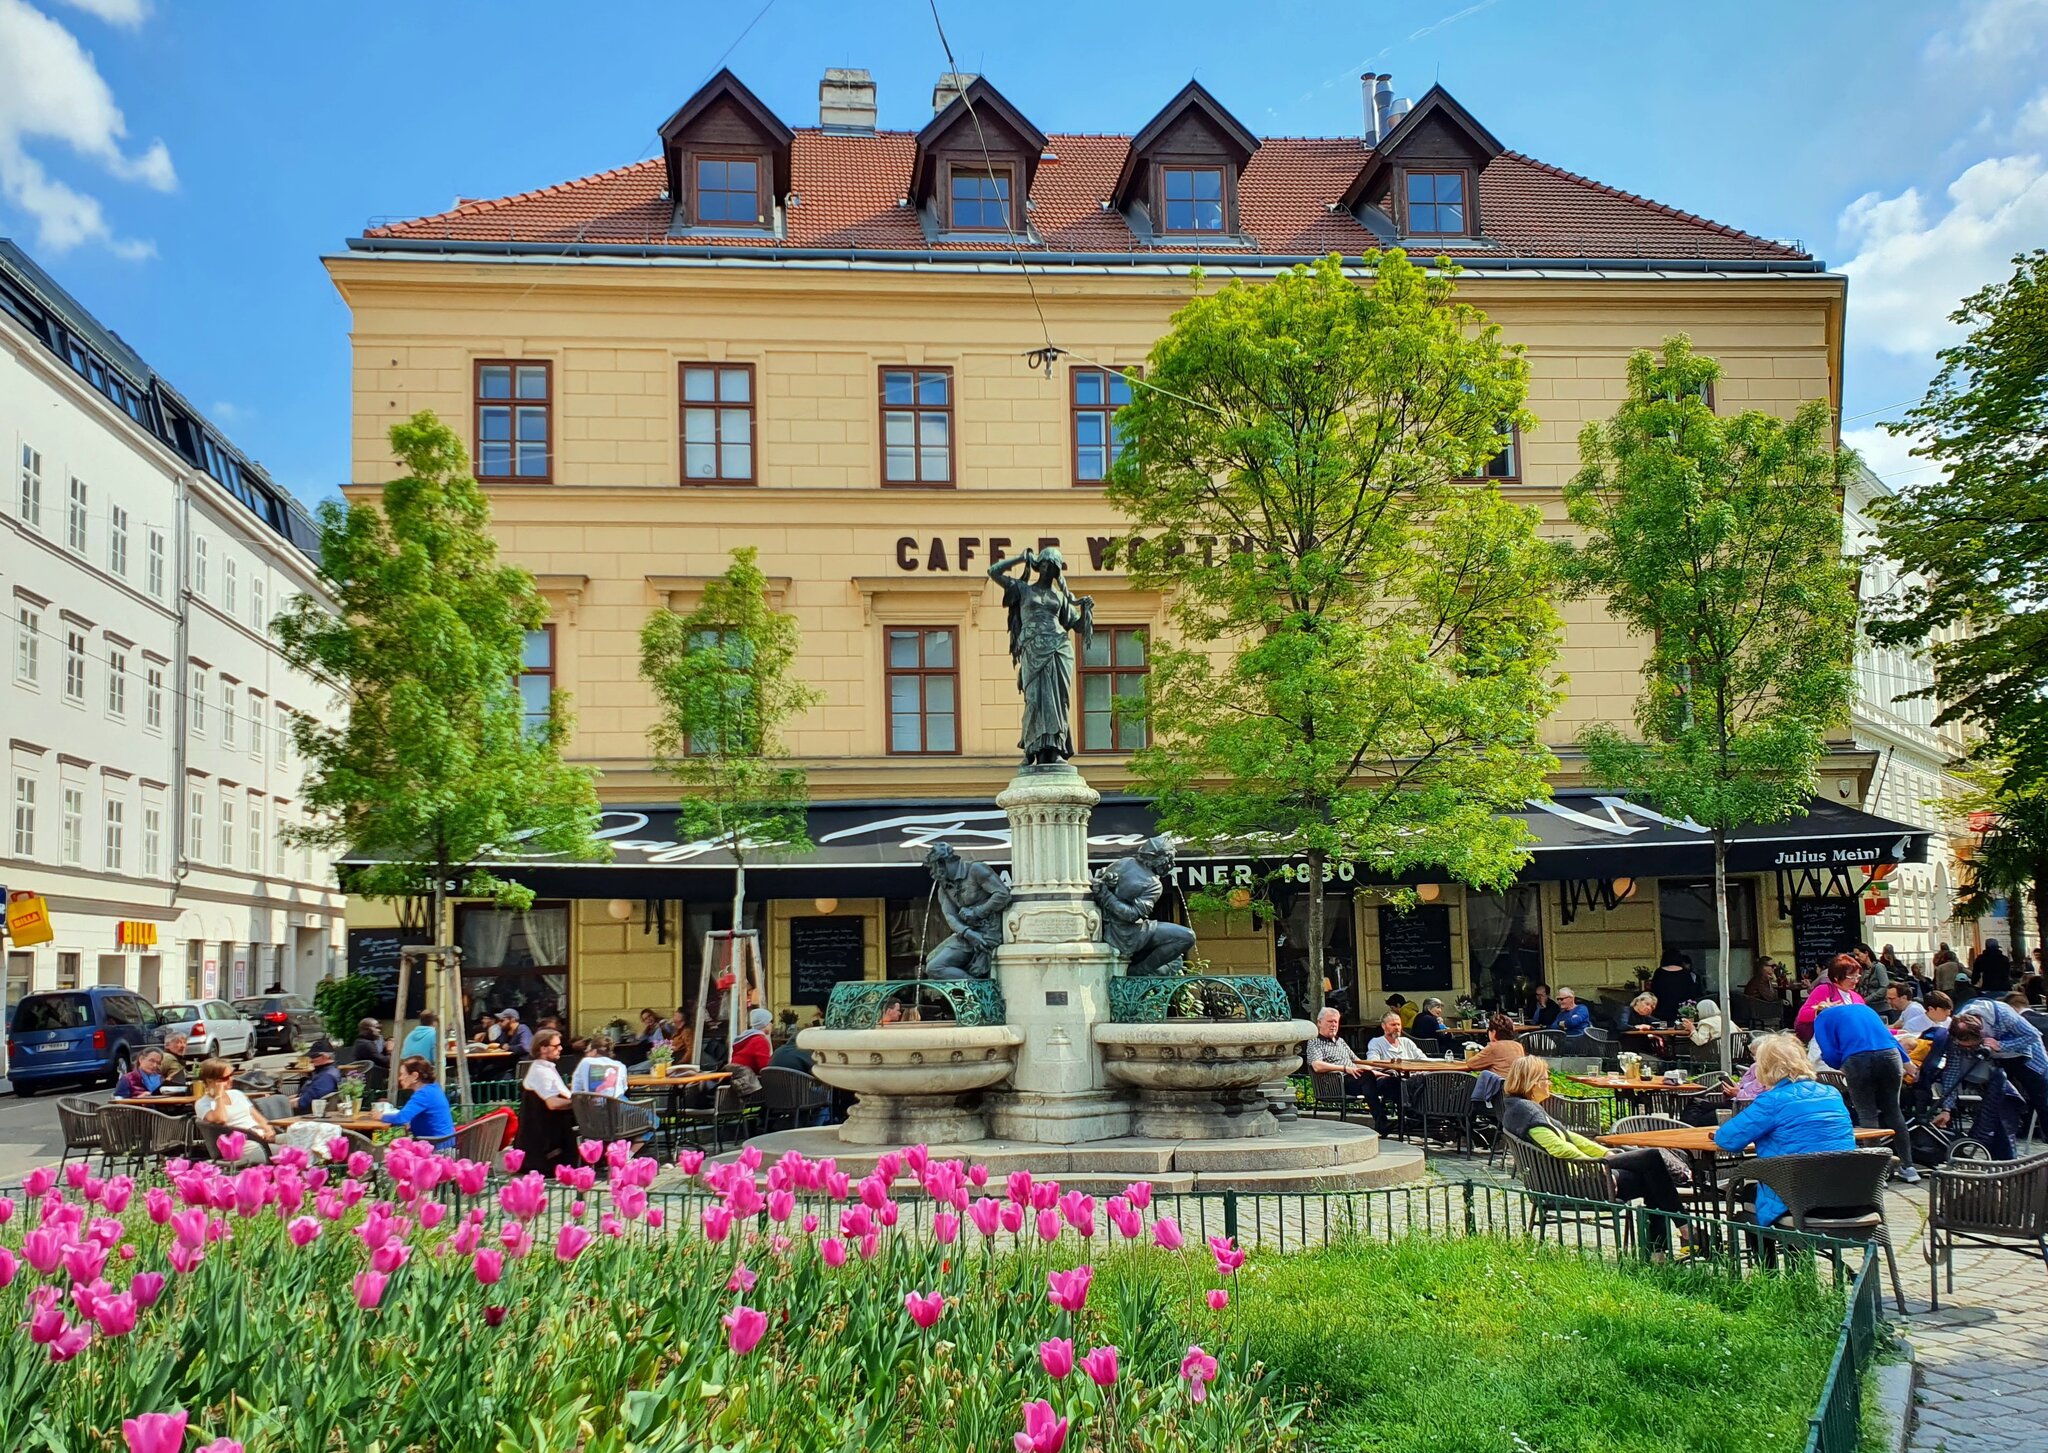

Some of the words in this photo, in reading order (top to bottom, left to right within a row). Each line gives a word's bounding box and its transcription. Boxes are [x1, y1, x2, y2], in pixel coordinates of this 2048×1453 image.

[896, 536, 1012, 572] CAFE
[1774, 851, 1827, 865] Julius
[1832, 848, 1881, 862] Meinl
[119, 921, 158, 945] BILLA
